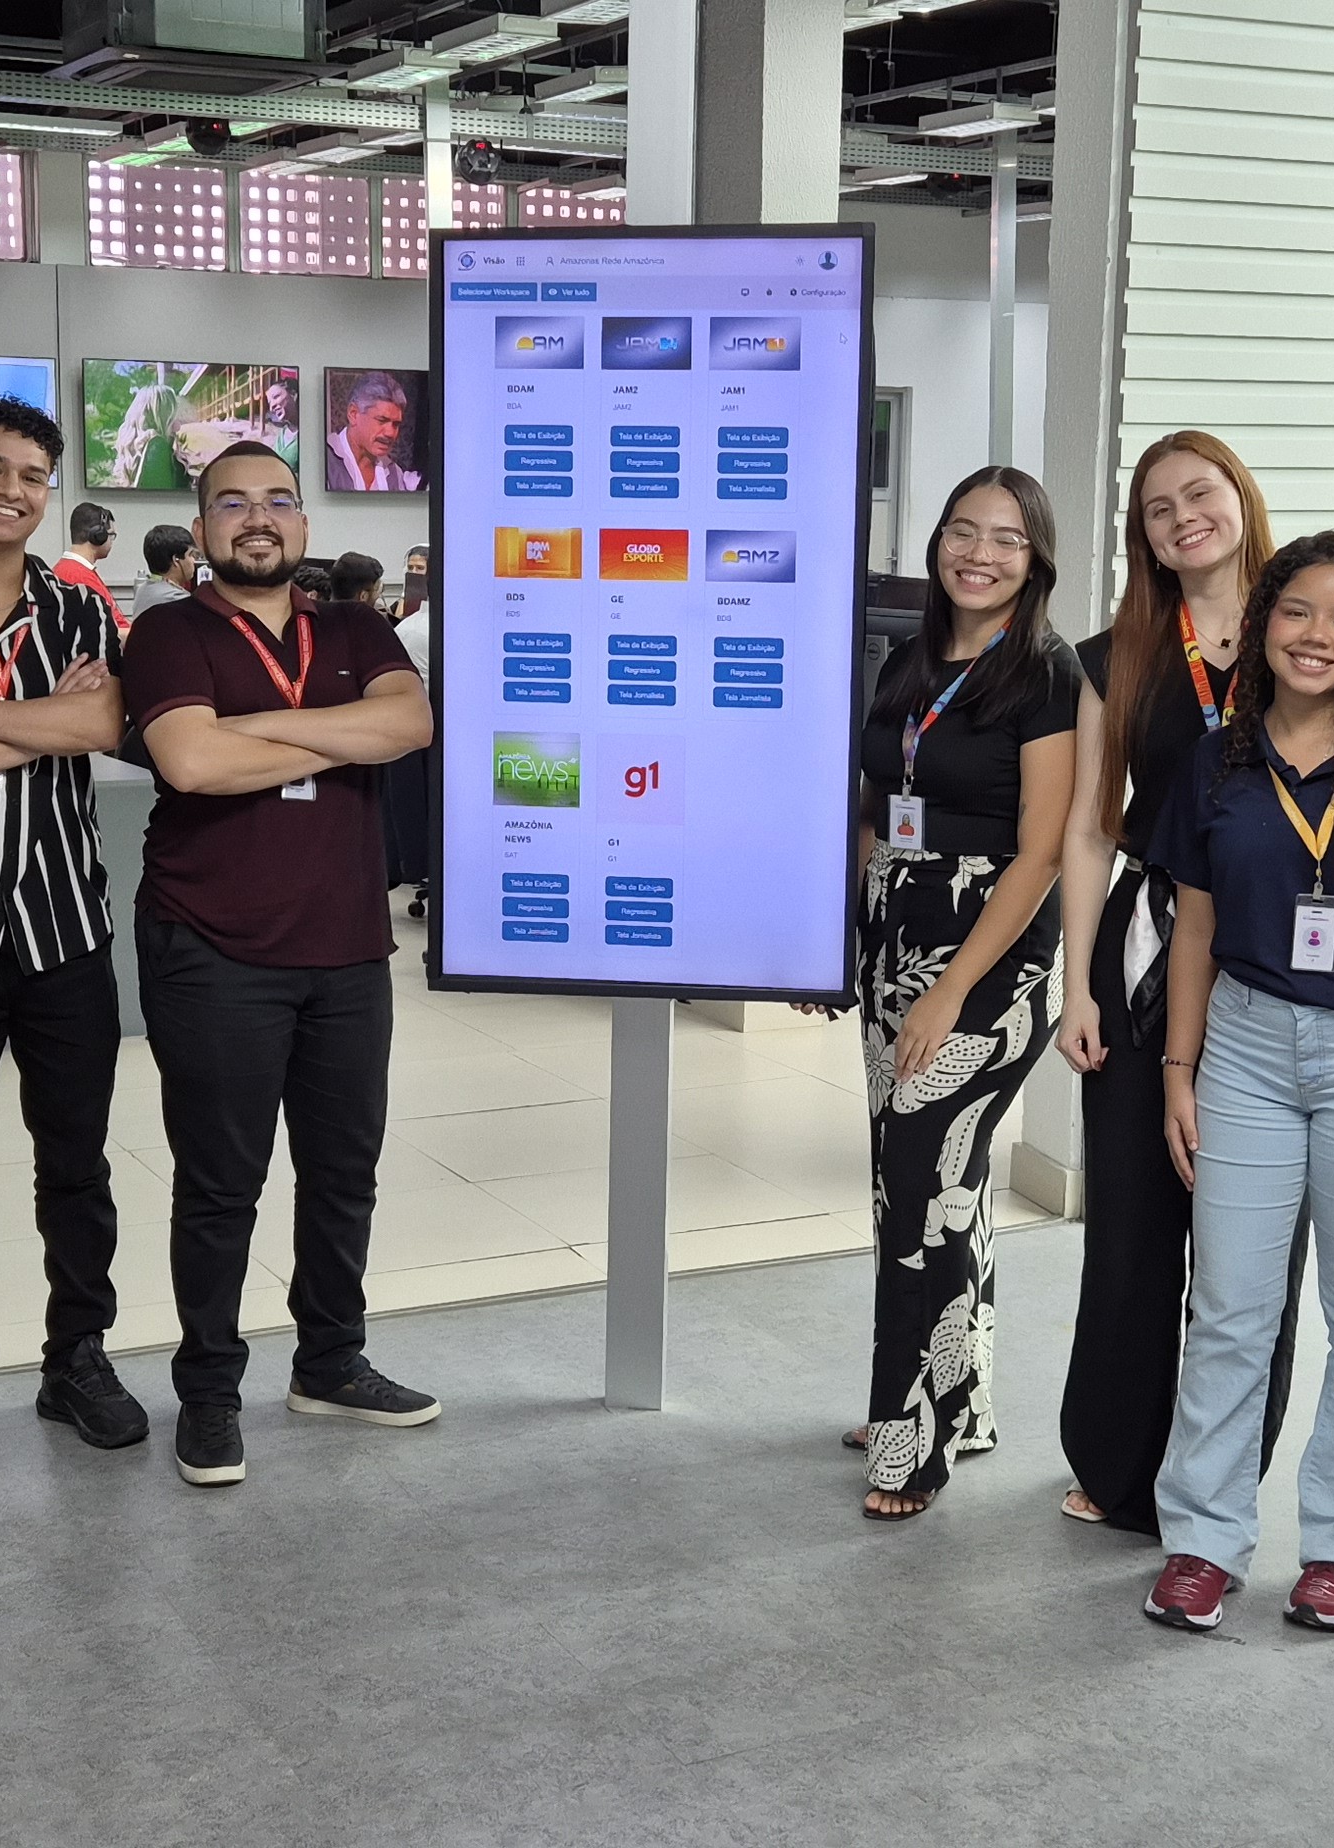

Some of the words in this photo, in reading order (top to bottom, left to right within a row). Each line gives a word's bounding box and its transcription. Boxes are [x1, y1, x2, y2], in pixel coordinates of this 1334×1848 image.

[483, 256, 505, 265] Visão
[801, 288, 846, 298] Configuração
[507, 385, 535, 393] BDAM
[613, 386, 638, 394] JAM2
[537, 432, 565, 441] Exibição
[619, 432, 633, 440] Tela
[644, 433, 673, 442] Exibição
[727, 434, 740, 442] Tela
[751, 434, 780, 443] Exibição
[521, 457, 557, 466] Regressiva
[627, 458, 663, 468] Regressiva
[733, 460, 771, 468] Regressiva
[516, 482, 529, 490] Tela
[627, 544, 661, 554] GLOBO
[623, 553, 664, 562] ESPORTE
[505, 593, 525, 601] BDS
[717, 598, 751, 606] BDAMZ
[511, 638, 525, 646] Tela
[537, 640, 564, 648] Exibição
[641, 642, 669, 651] Exibição
[747, 644, 776, 654] Exibição
[519, 664, 555, 672] Regressiva
[624, 666, 661, 674] Regressiva
[730, 668, 767, 678] Regressiva
[515, 688, 527, 696] Tela
[498, 758, 569, 782] news
[624, 761, 659, 798] g1
[505, 820, 553, 830] AMAZÔNIA
[505, 836, 531, 844] NEWS
[607, 838, 620, 846] G1
[535, 880, 562, 889] Exibição
[638, 884, 665, 894] Exibição
[517, 904, 553, 912] Regressiva
[621, 908, 657, 916] Regressiva
